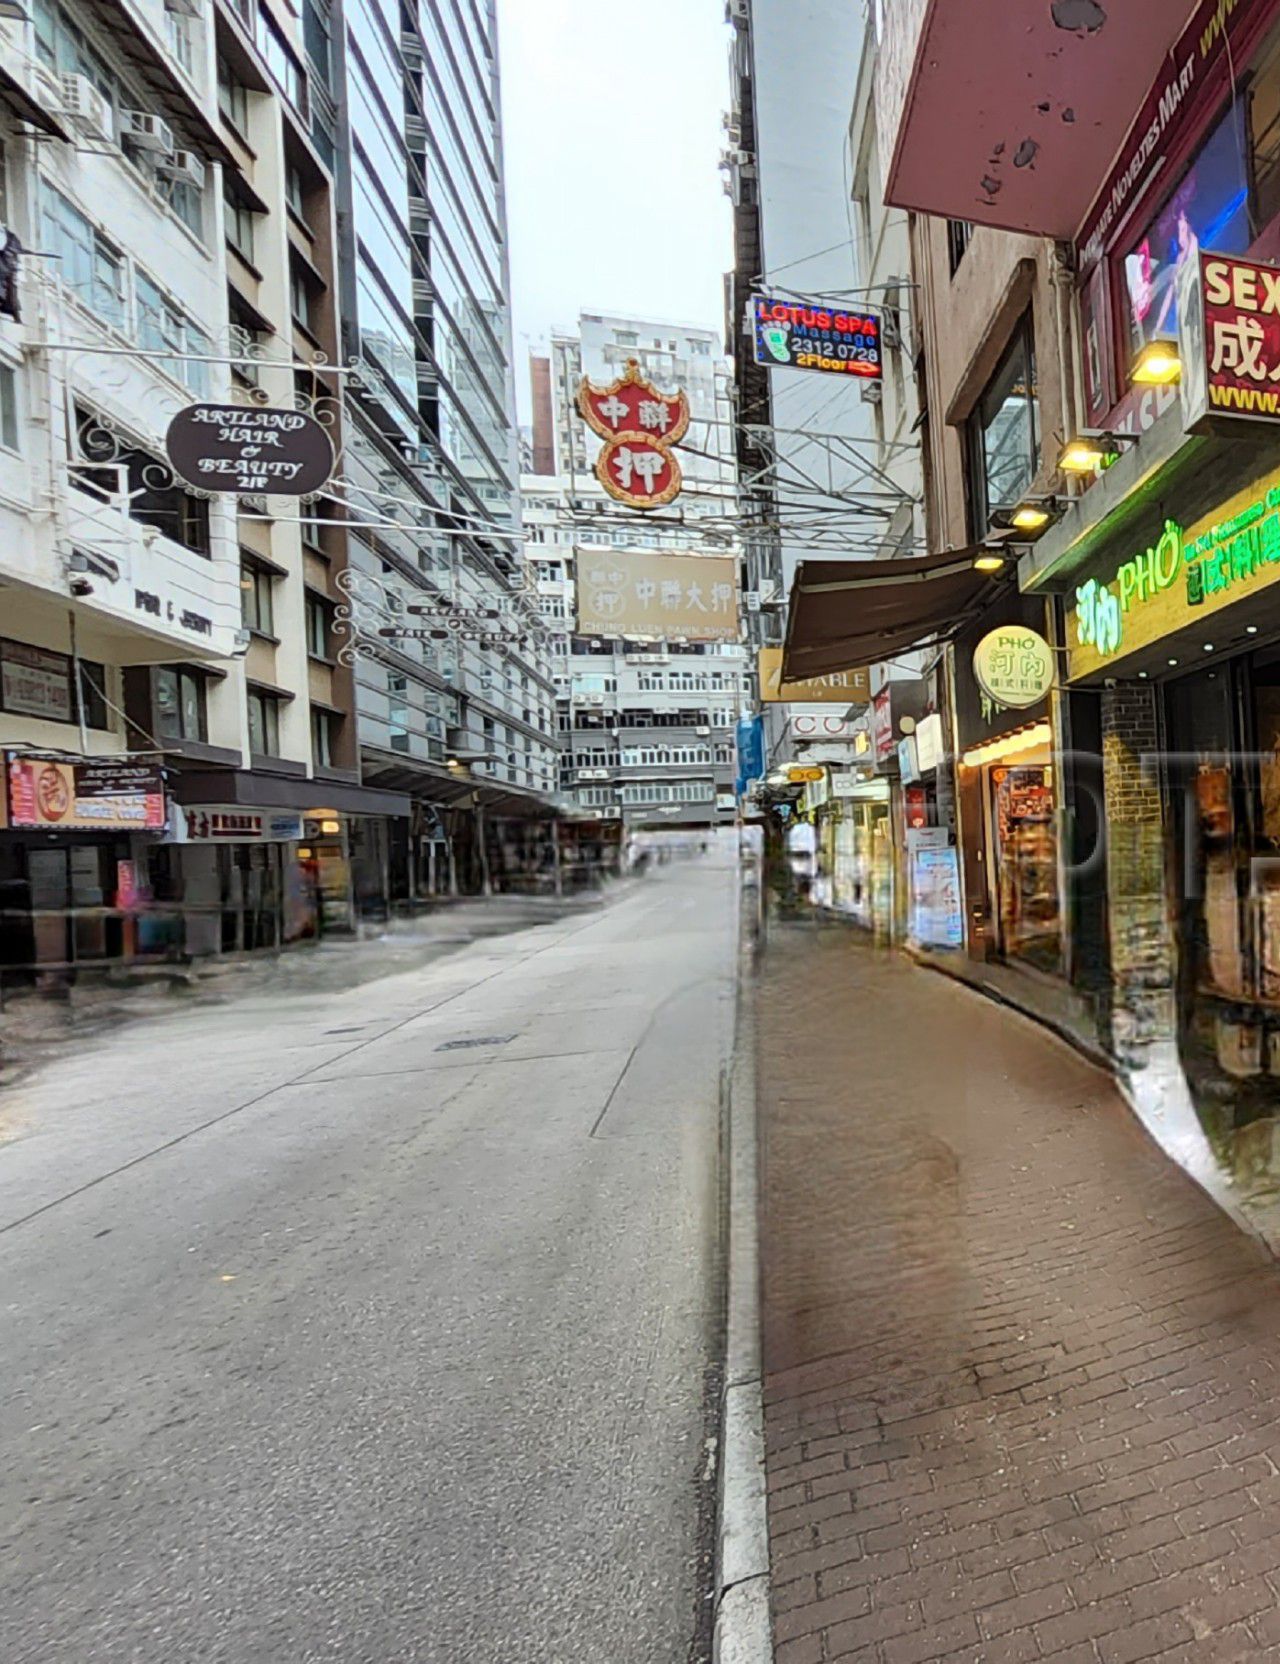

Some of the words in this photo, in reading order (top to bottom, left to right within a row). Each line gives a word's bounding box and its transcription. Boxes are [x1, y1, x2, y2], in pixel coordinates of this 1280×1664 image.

[1111, 115, 1161, 214] NOVELTIES
[1158, 52, 1196, 132] MART
[760, 302, 831, 330] LOTUS
[834, 314, 877, 336] SPA
[793, 324, 876, 348] Massage
[791, 338, 834, 356] 2312
[837, 345, 878, 362] 0728
[192, 408, 306, 432] ARTLAND
[217, 427, 284, 448] HAIR
[198, 458, 304, 480] BEAUTY
[612, 446, 666, 494] 押
